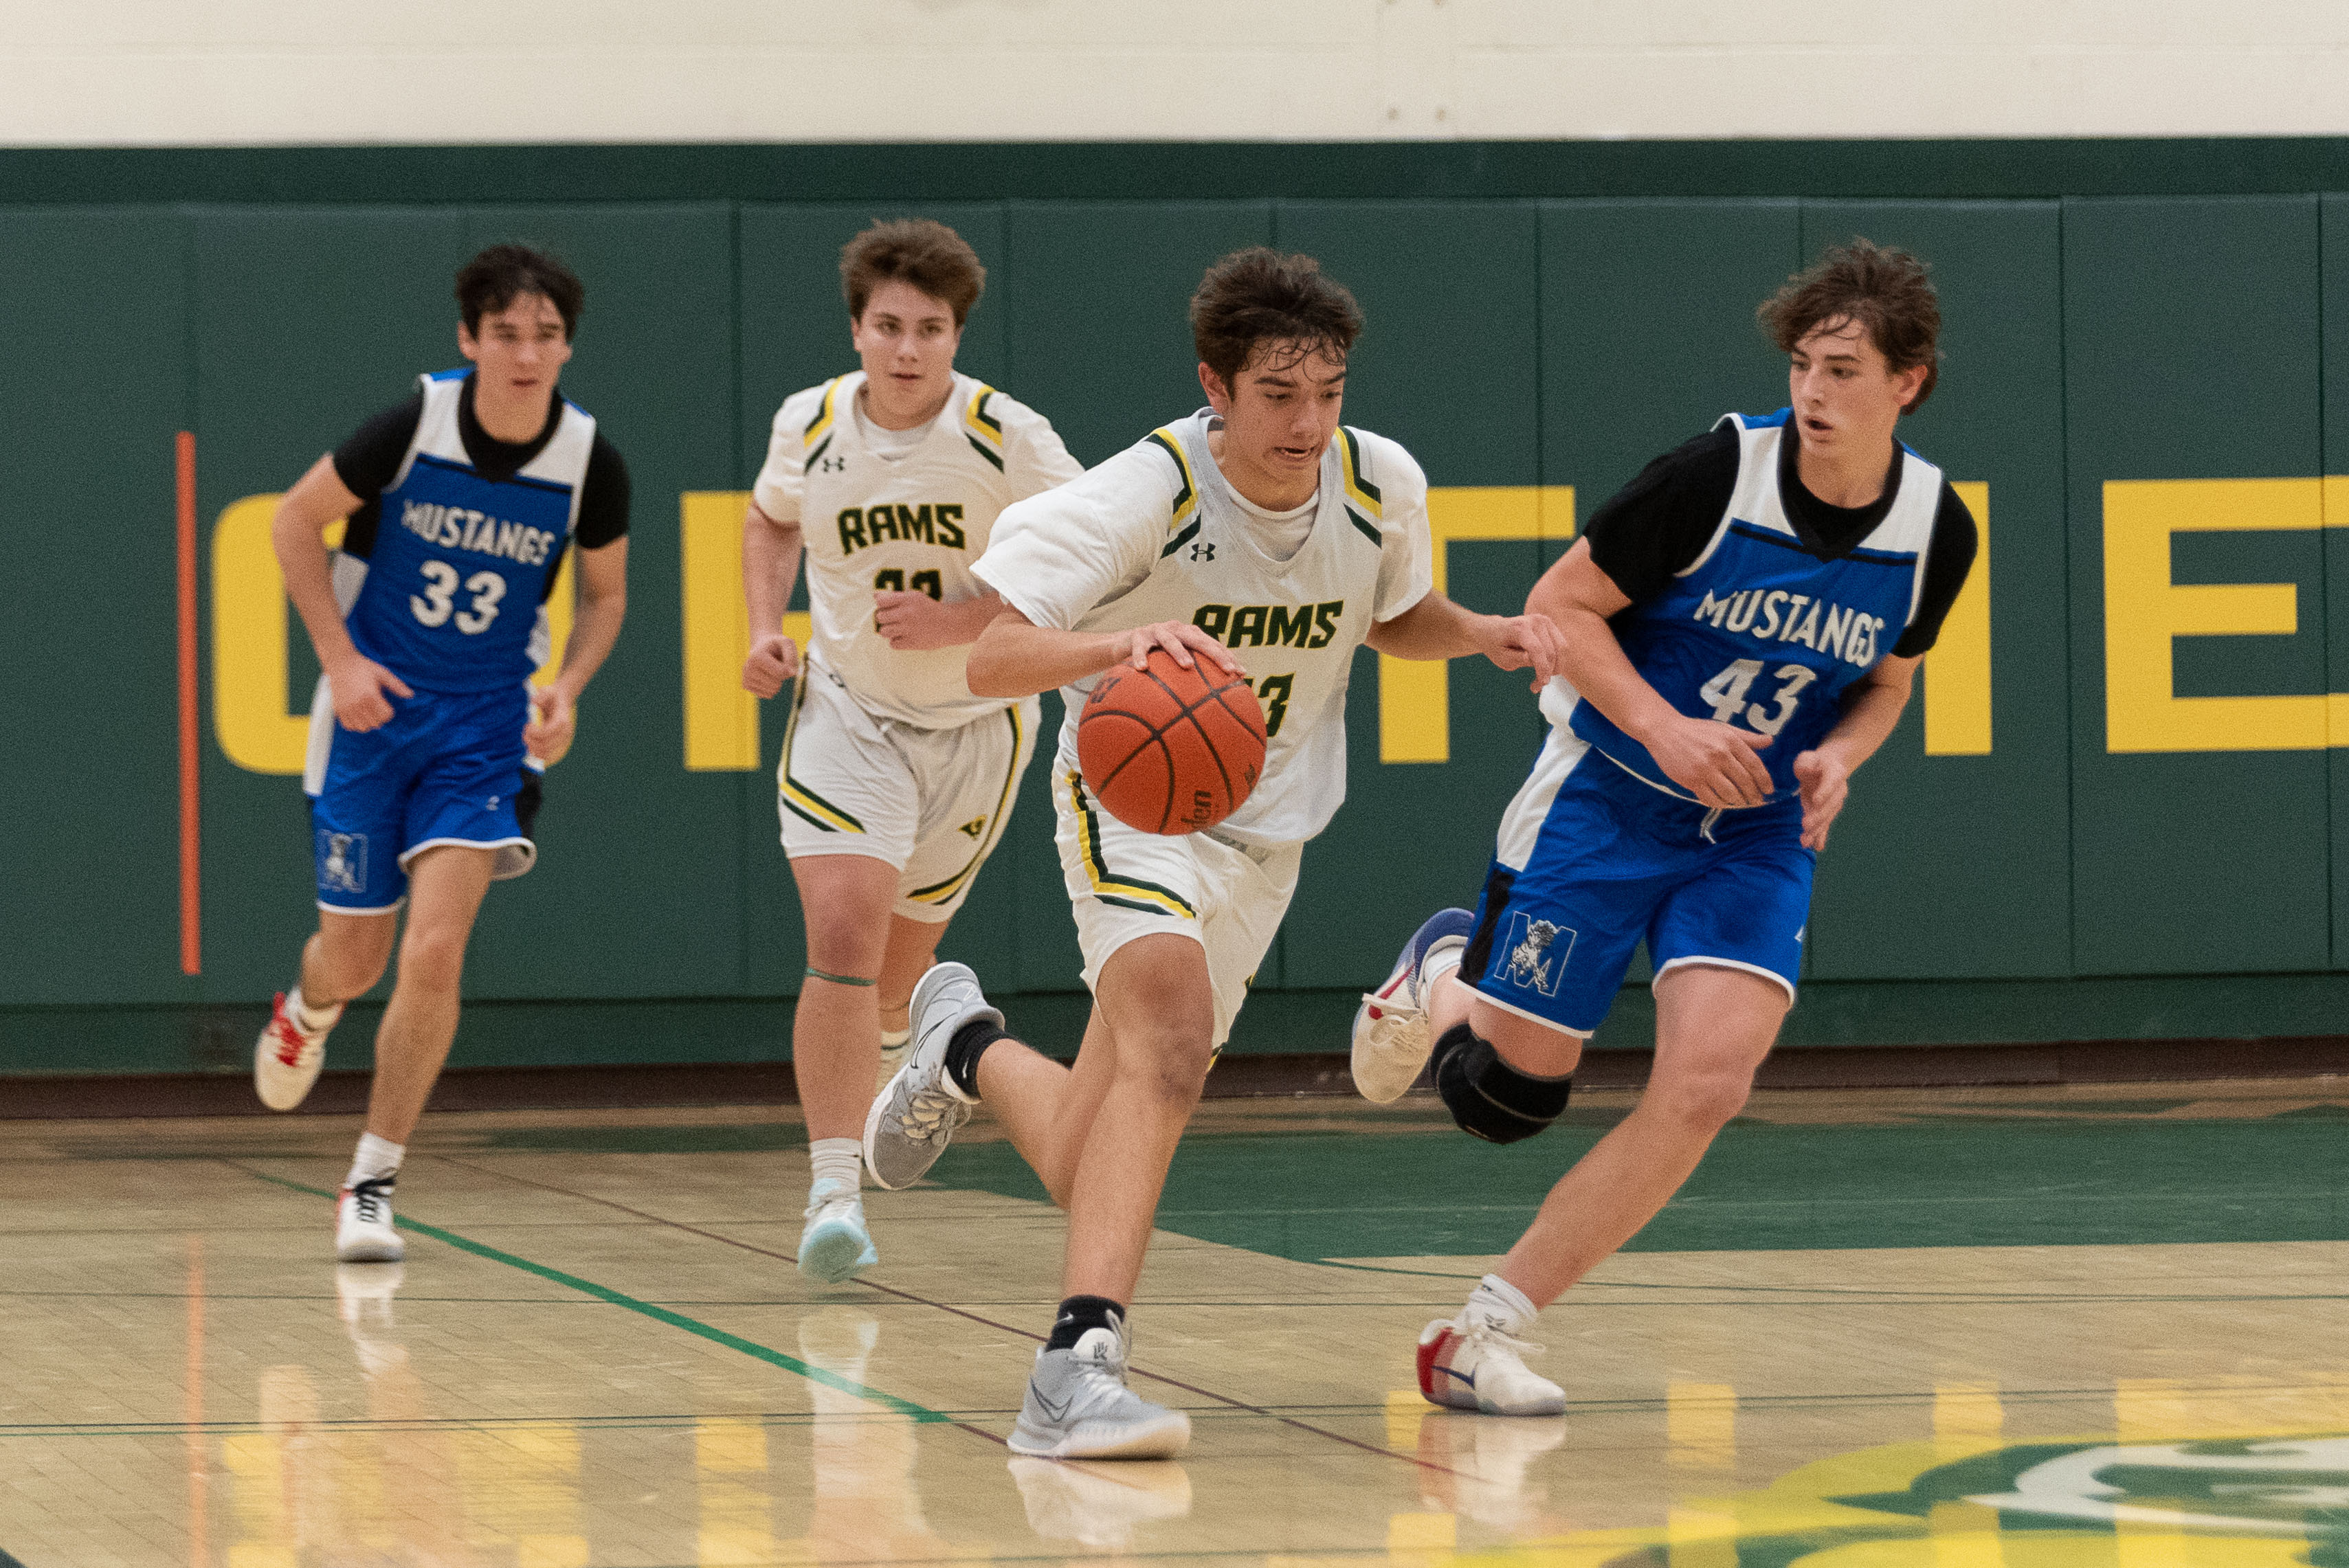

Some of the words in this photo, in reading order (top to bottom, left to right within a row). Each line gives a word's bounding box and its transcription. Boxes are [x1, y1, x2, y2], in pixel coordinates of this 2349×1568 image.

[401, 499, 556, 567] MUSTANGS
[837, 503, 966, 557] RAMS
[410, 559, 507, 636] 33
[1191, 599, 1344, 649] RAMS
[1693, 588, 1885, 668] MUSTANGS
[1243, 671, 1297, 738] 3
[1699, 658, 1818, 736] 43
